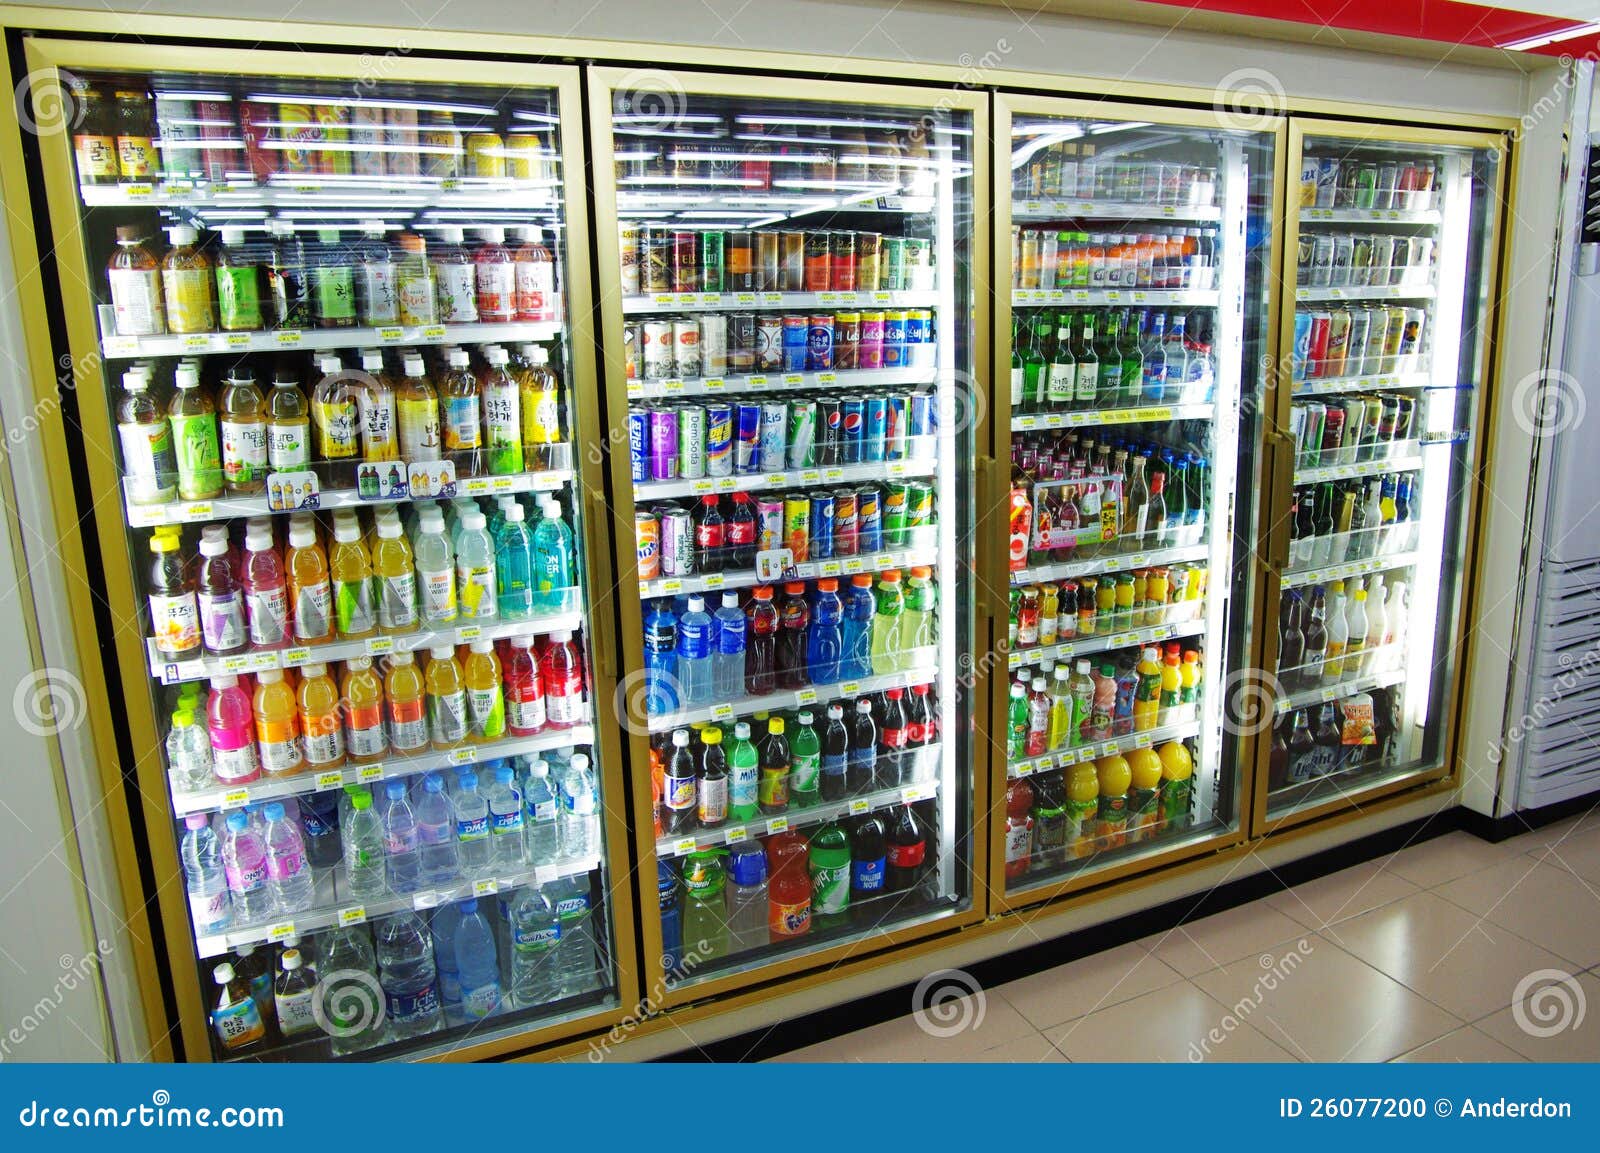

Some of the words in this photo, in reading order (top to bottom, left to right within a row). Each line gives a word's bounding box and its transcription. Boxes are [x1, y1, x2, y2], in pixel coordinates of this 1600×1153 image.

[487, 400, 512, 411] 아침
[488, 410, 511, 423] 헛개
[690, 416, 700, 466] DemiSoda
[863, 881, 879, 889] NOW
